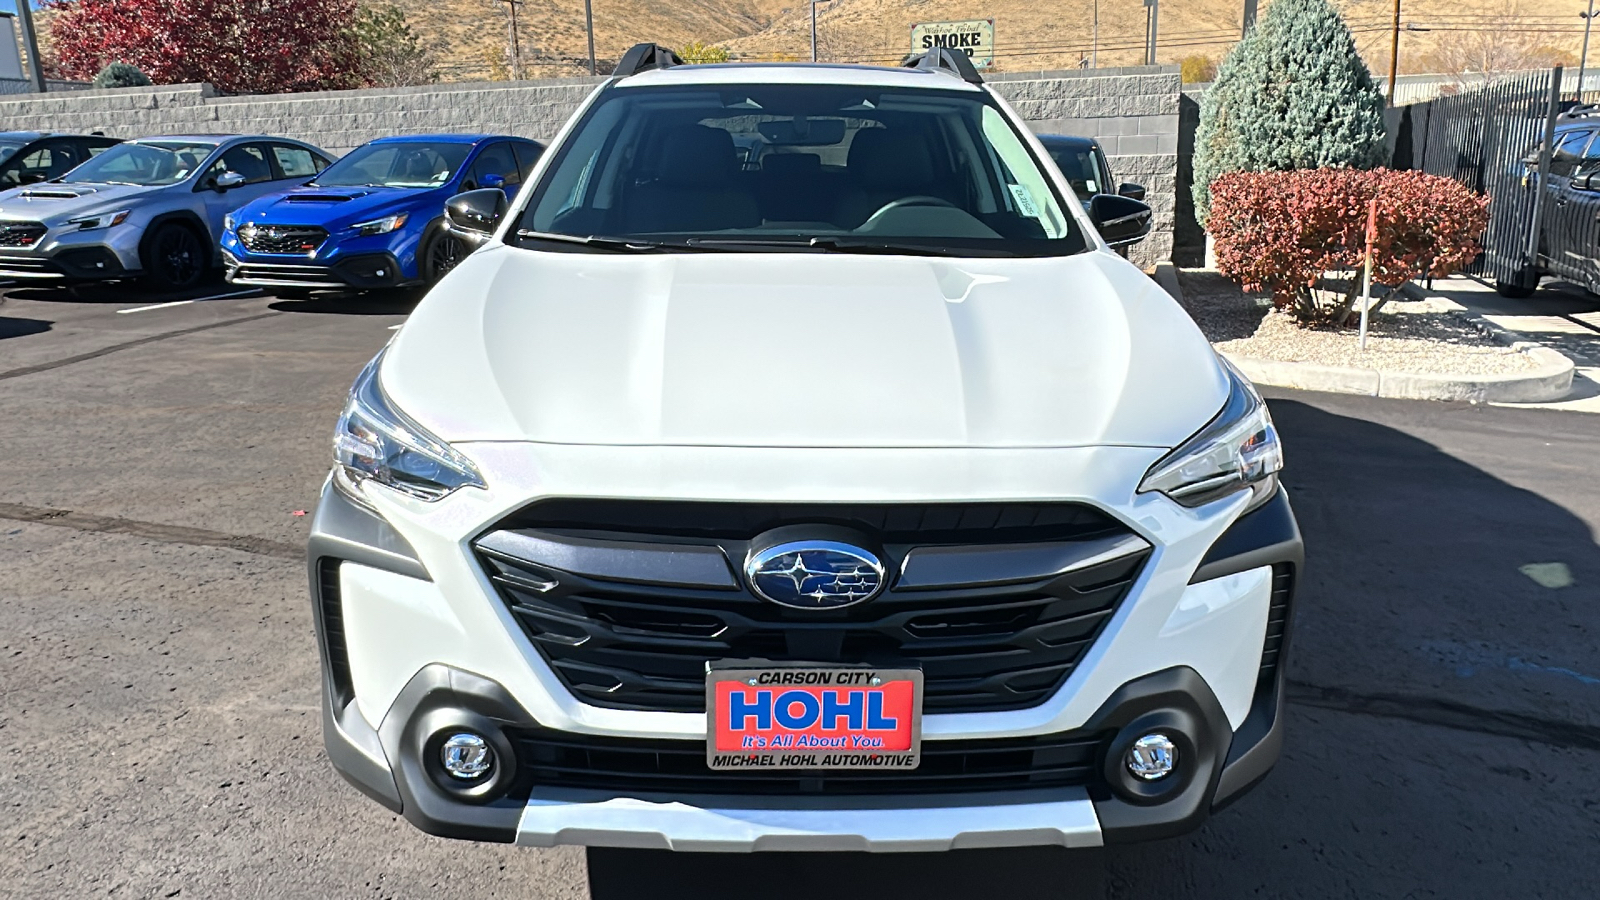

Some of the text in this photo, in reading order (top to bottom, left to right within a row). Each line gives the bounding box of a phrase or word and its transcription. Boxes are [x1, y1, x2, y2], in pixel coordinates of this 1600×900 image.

[922, 32, 981, 48] SMOKE
[758, 672, 876, 685] CARSON CITY
[729, 690, 898, 731] HOHL
[742, 735, 766, 748] It's
[771, 735, 793, 747] All
[796, 735, 847, 747] About
[712, 755, 914, 766] MICHAEL HOHL AUTOMOTIVE
